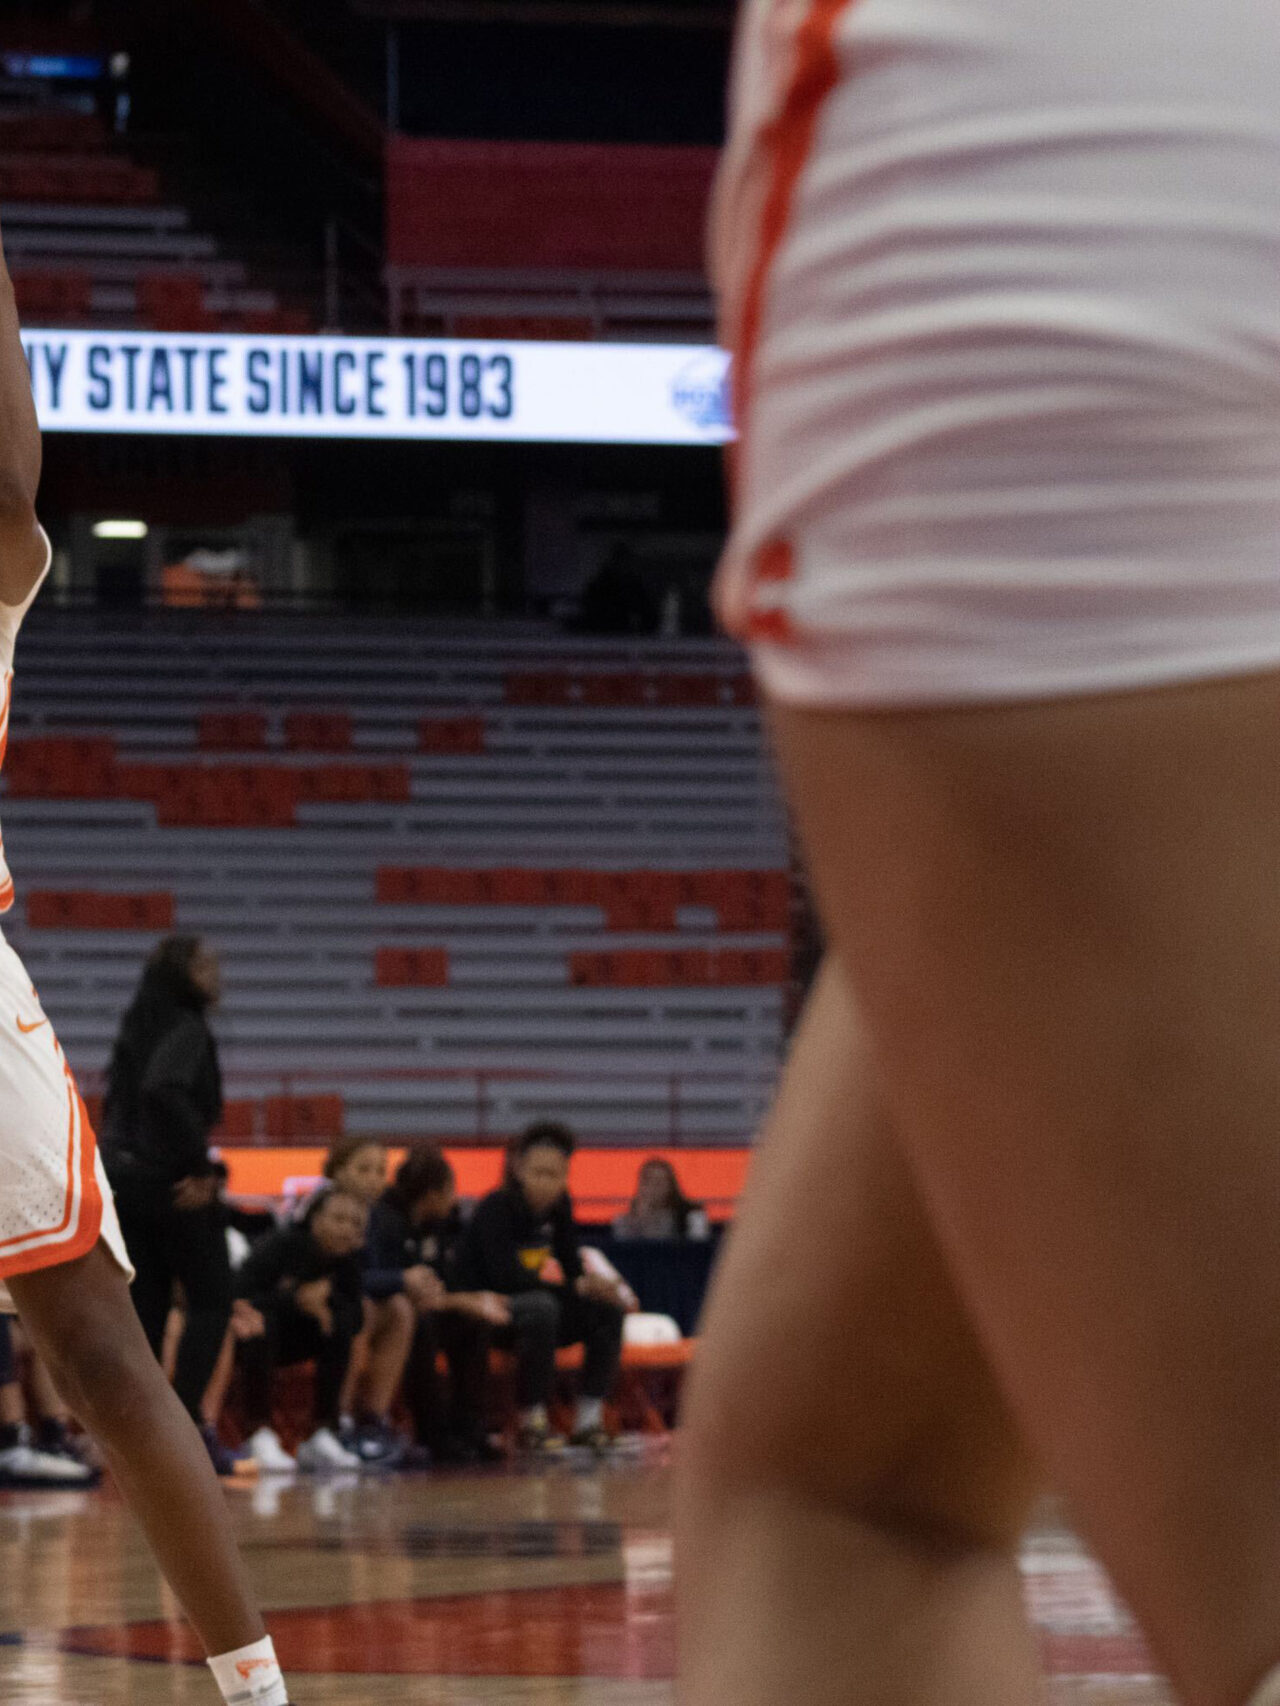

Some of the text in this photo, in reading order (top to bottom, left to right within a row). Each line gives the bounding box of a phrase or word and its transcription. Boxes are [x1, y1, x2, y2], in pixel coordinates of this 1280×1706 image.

[87, 345, 228, 413] STATE
[247, 349, 386, 416] SINCE
[403, 352, 514, 419] 1983
